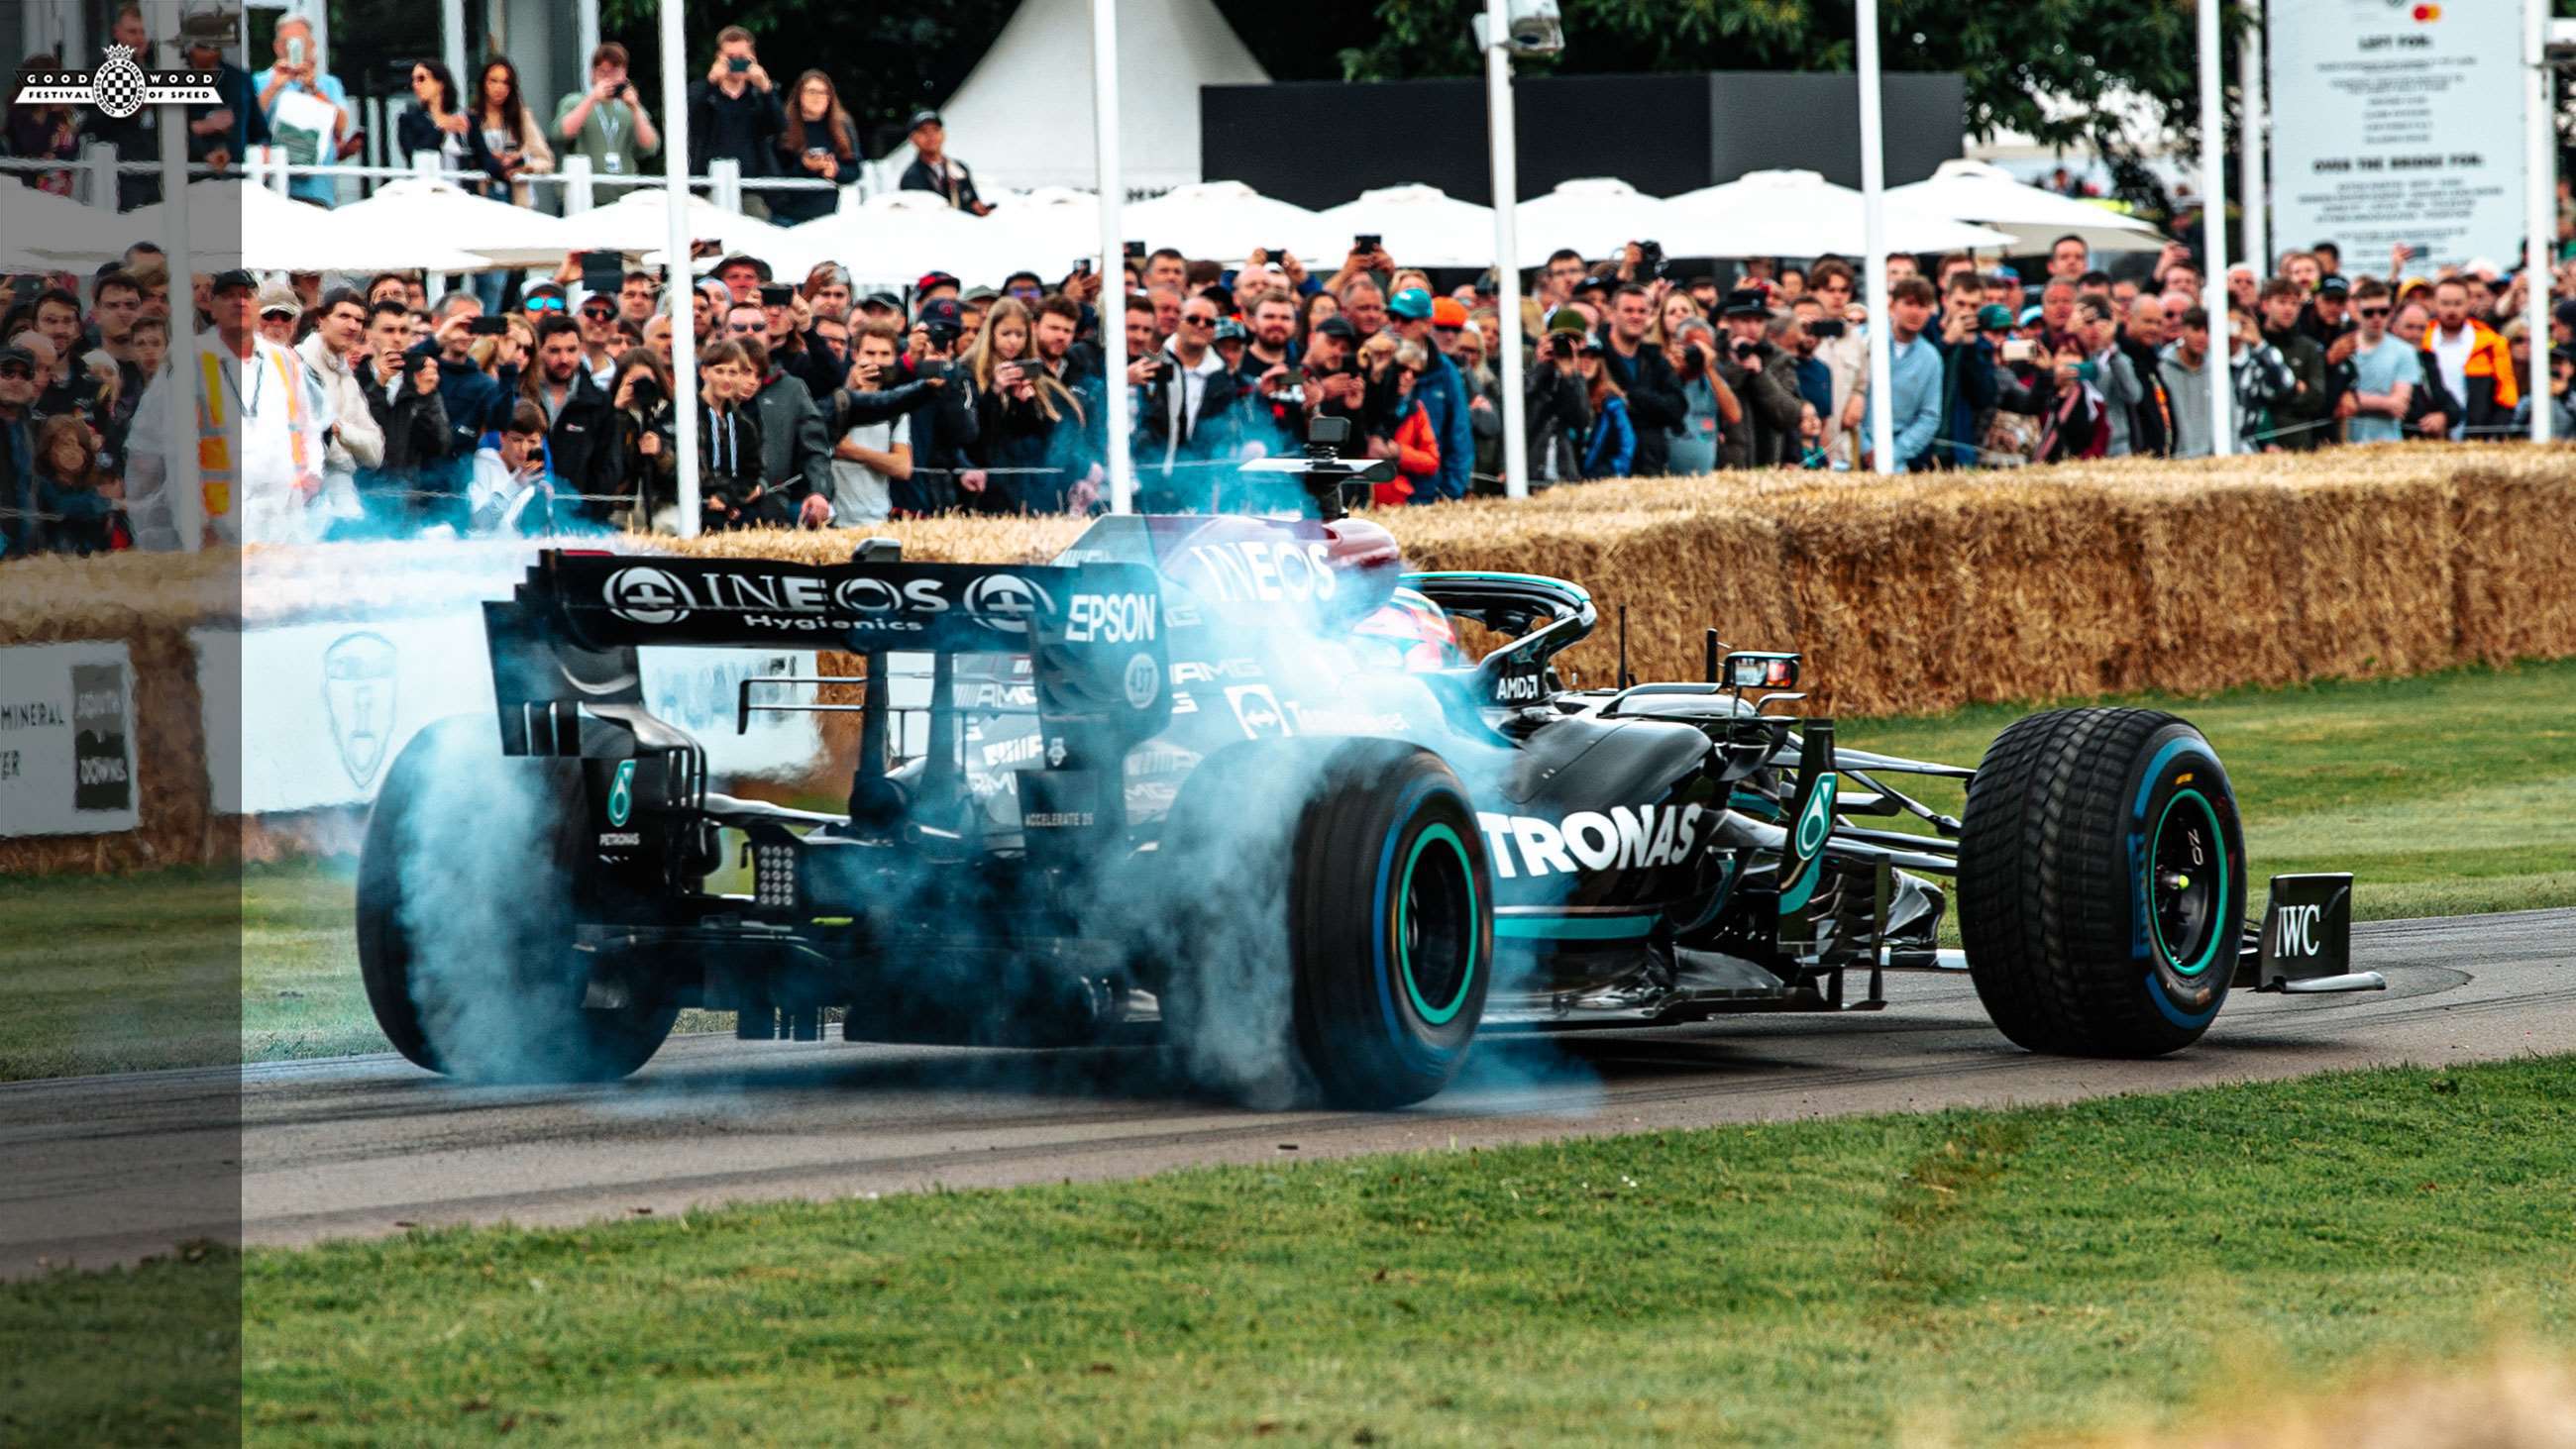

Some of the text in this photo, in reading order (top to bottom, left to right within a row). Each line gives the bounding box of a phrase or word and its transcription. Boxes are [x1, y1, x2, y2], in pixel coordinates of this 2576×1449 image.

[1190, 541, 1336, 602] INEOS
[700, 572, 950, 612] INEOS
[743, 613, 924, 631] Hygienics
[1065, 593, 1157, 643] EPSON
[1496, 676, 1529, 699] AMD
[1, 702, 64, 730] MINERAL
[2274, 903, 2320, 958] IWC
